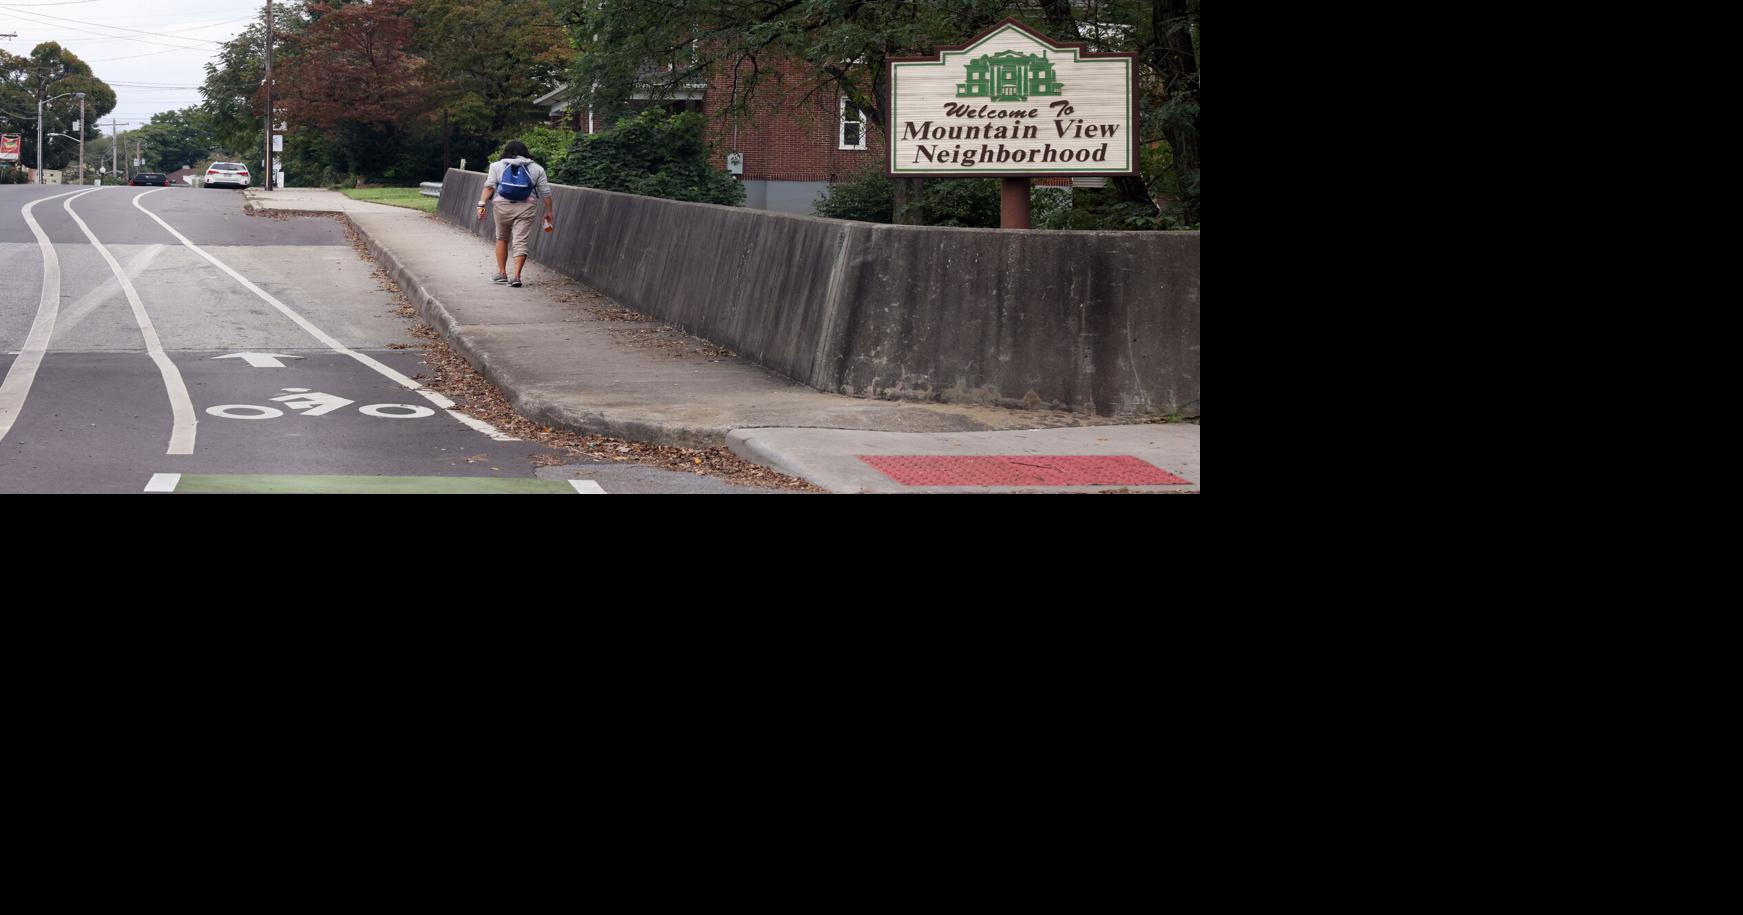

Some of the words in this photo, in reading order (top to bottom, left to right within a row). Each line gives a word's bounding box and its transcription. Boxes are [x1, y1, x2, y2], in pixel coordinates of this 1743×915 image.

[944, 102, 1038, 119] Welcome
[1049, 100, 1075, 116] To
[902, 120, 1038, 141] Mountain
[1053, 119, 1120, 139] View
[912, 143, 1108, 167] Neighborhood
